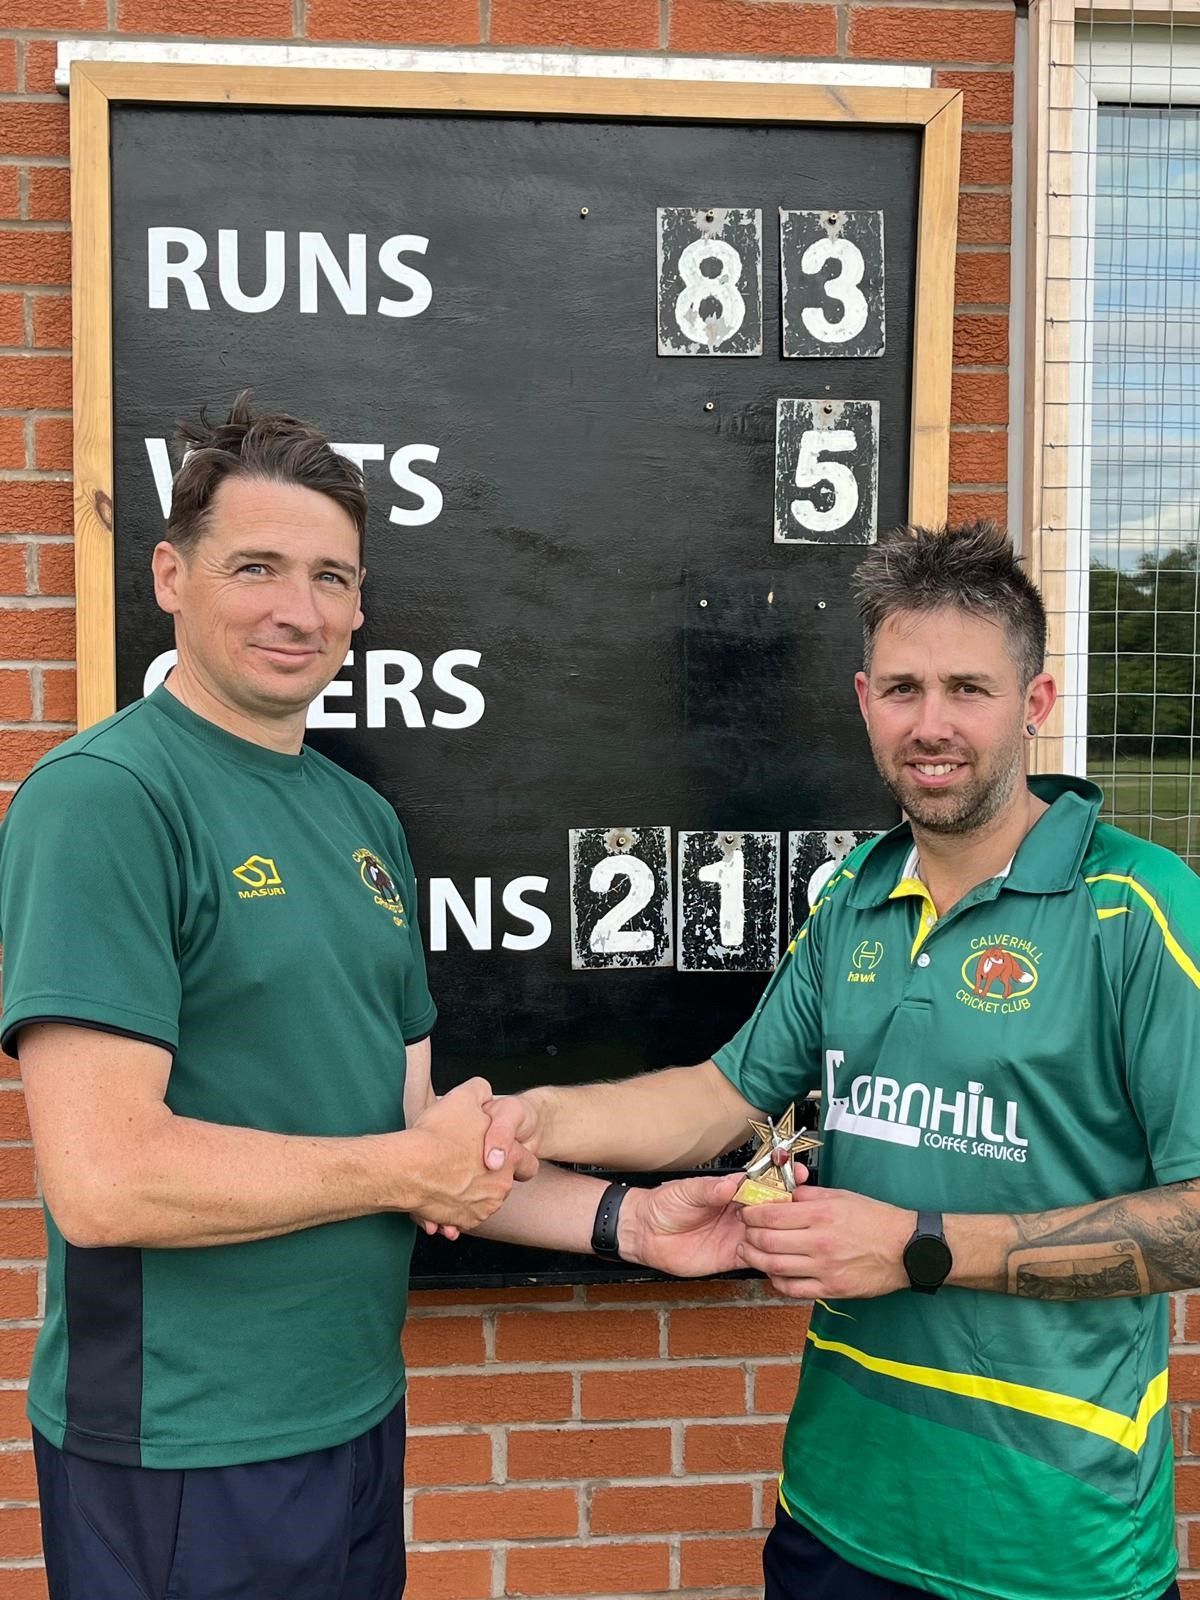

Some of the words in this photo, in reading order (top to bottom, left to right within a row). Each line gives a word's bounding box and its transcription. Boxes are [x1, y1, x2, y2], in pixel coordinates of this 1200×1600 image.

[147, 226, 434, 318] RUNS
[790, 429, 859, 532] 5
[143, 648, 486, 730] ERS
[238, 887, 286, 899] MASURI
[970, 934, 1044, 965] CALVERHALL
[847, 971, 876, 983] hawk
[955, 989, 1000, 1014] CRICKET
[1001, 998, 1031, 1014] CLUB
[924, 1132, 968, 1155] COFFEE
[971, 1141, 1027, 1163] SERVICES
